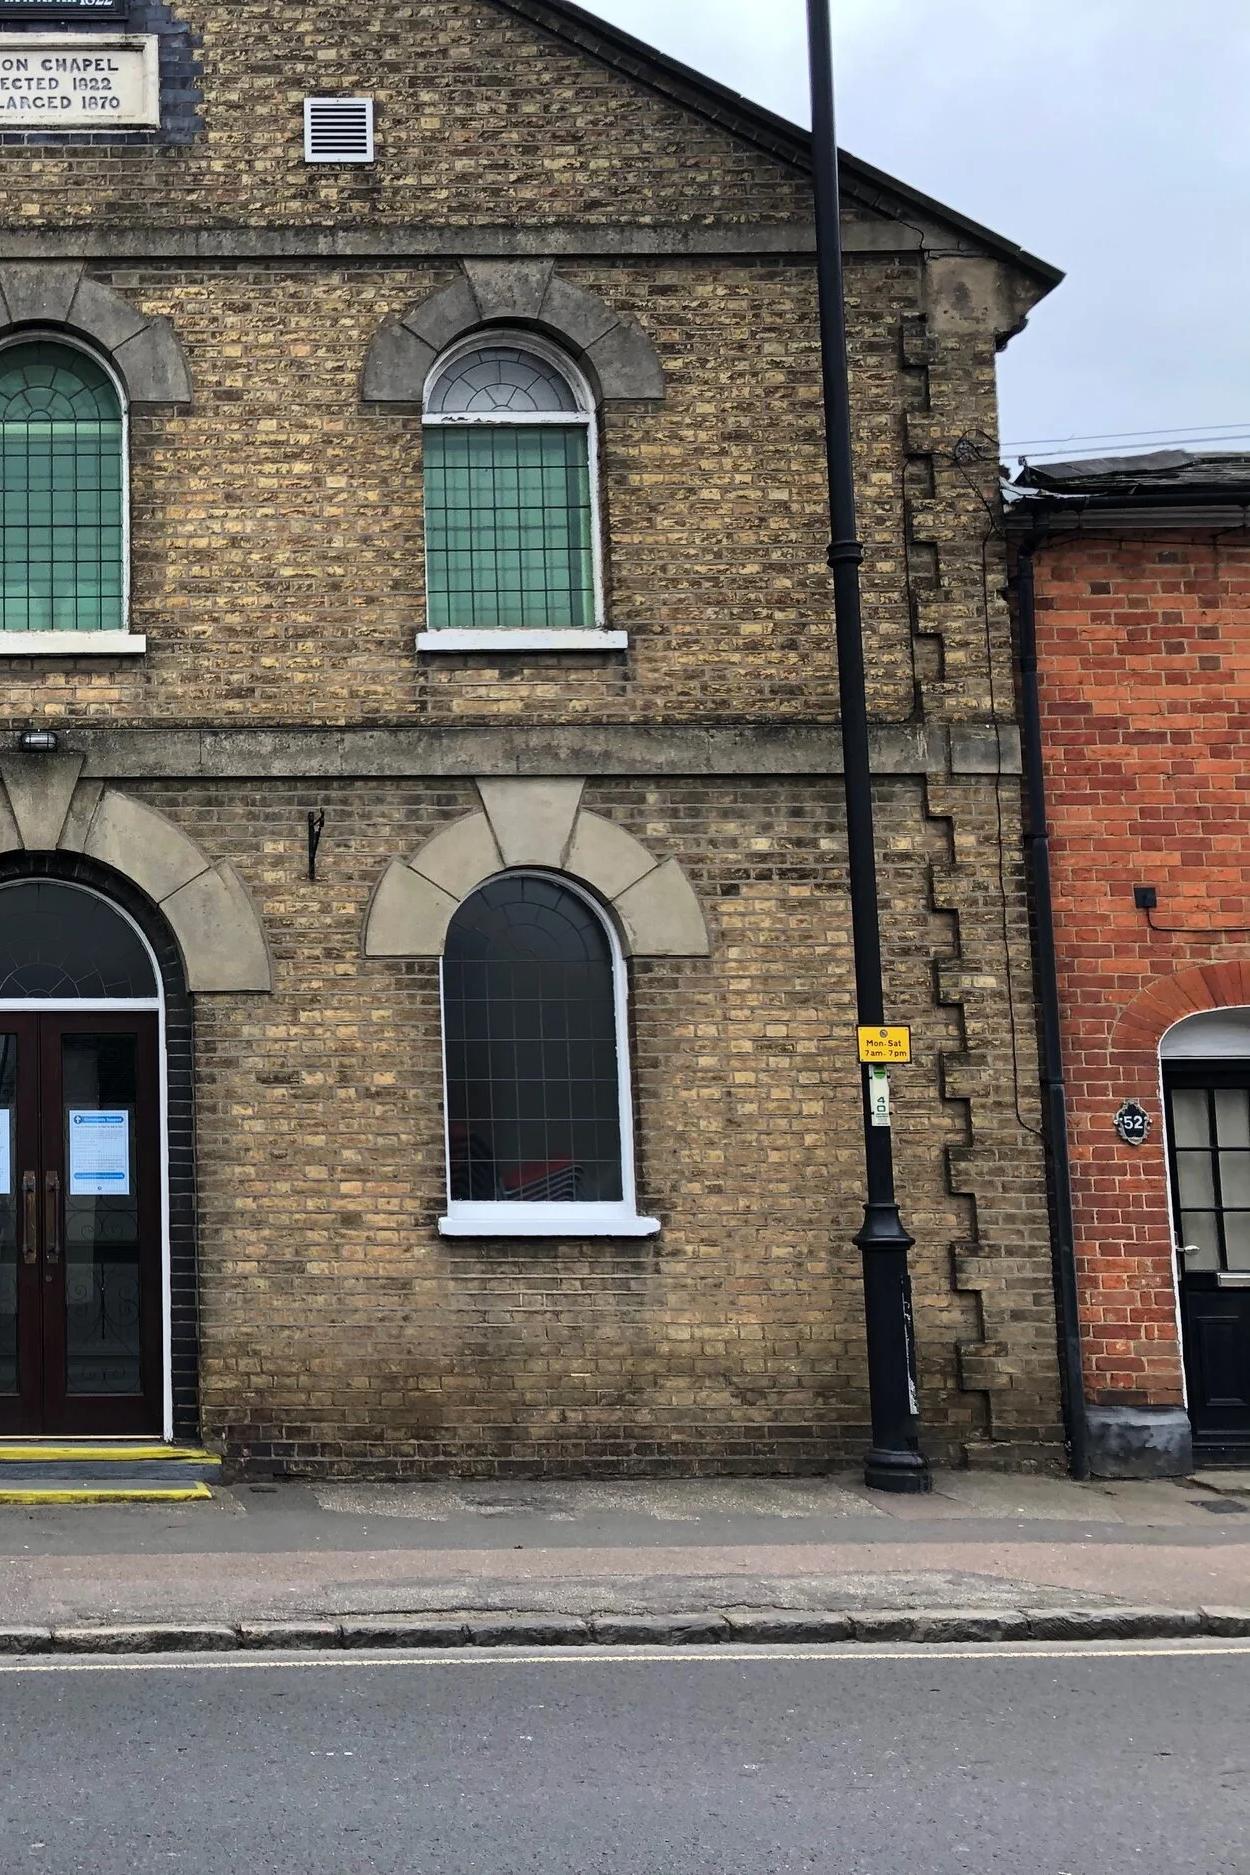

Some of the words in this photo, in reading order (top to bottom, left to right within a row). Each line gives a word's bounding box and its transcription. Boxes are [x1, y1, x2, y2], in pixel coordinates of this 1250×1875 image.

[40, 58, 120, 72] CHAPEL
[73, 77, 112, 91] 1822
[81, 96, 120, 110] 1870
[888, 1050, 907, 1058] 7pm
[1123, 1115, 1144, 1130] 52
